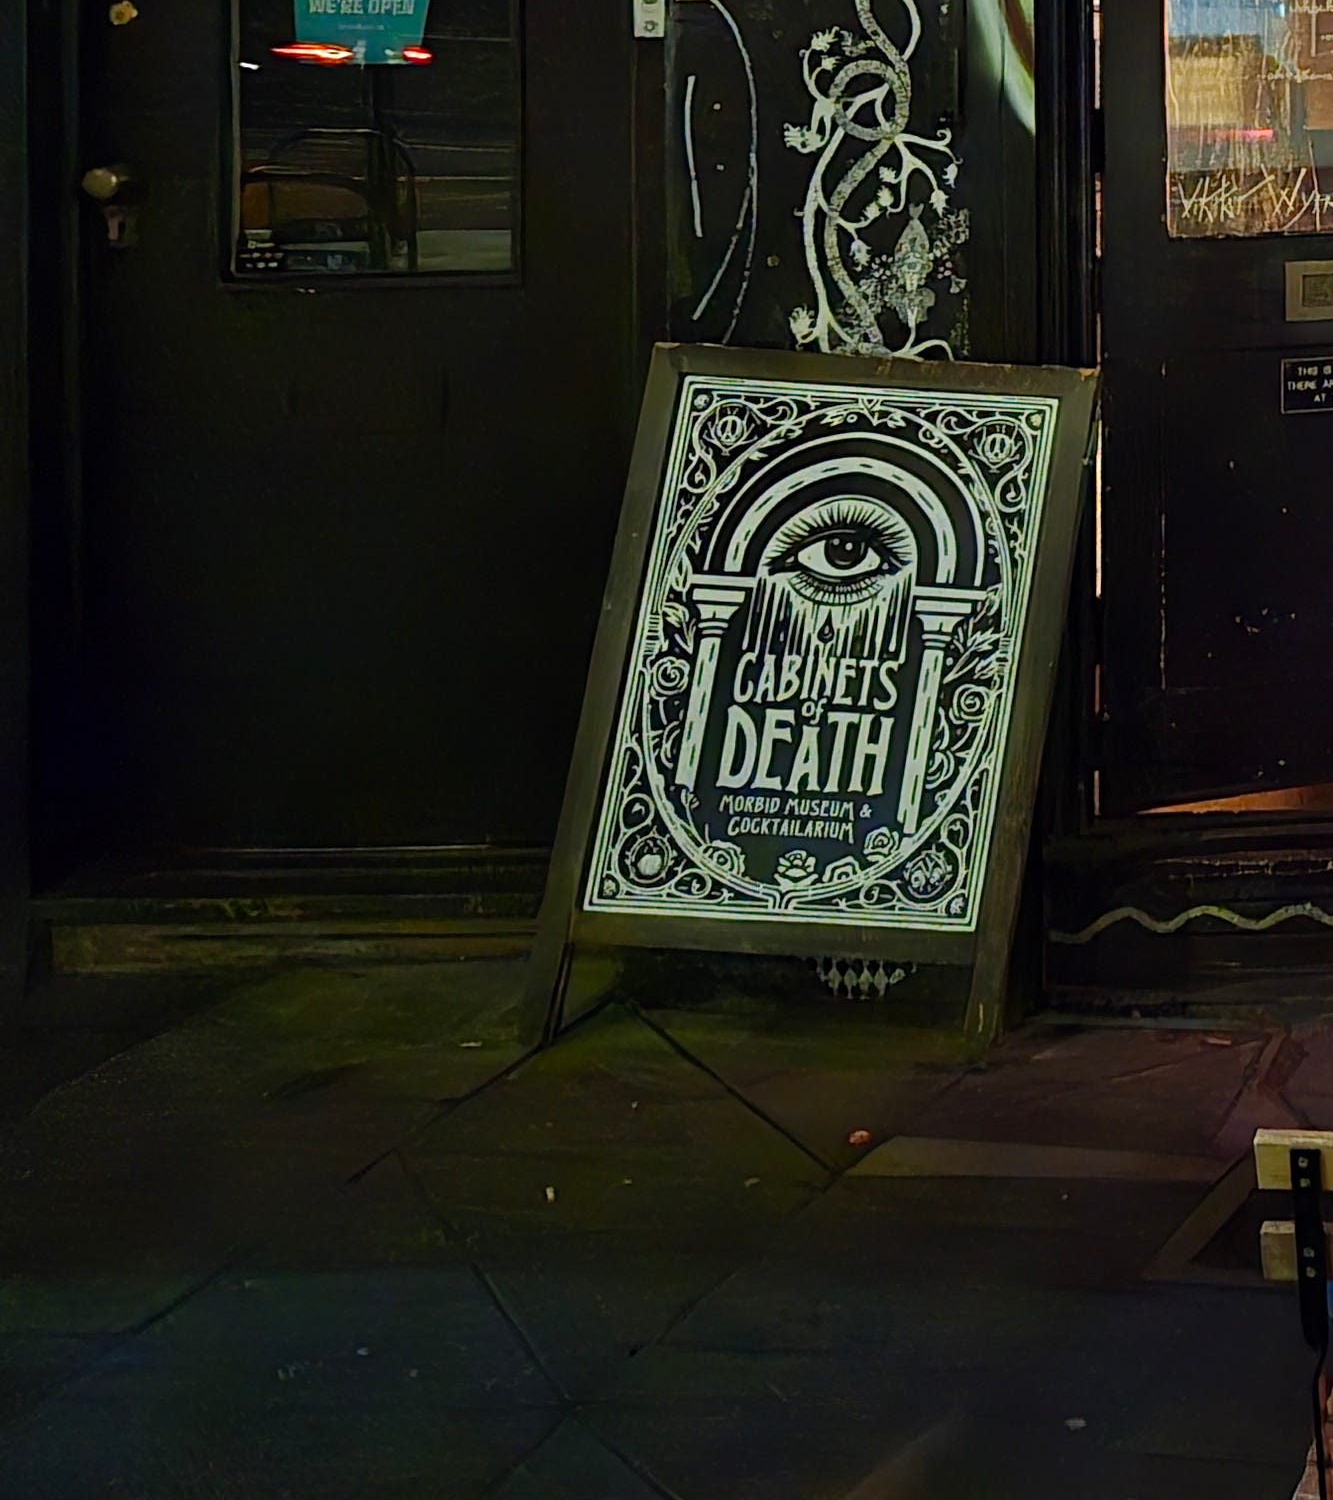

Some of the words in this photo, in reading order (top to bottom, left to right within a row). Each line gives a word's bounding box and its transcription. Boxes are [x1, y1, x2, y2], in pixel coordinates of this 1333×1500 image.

[1297, 366, 1318, 377] THIS
[1323, 365, 1332, 375] IS
[1287, 380, 1317, 390] THERE
[1313, 393, 1327, 403] AT
[732, 644, 900, 712] CABINETS
[801, 698, 828, 725] of
[715, 704, 896, 797] DEATH
[719, 794, 781, 816] MORBID
[784, 798, 856, 821] MUSEUM
[858, 803, 873, 819] &
[726, 816, 855, 845] COCKTAILARIUM
